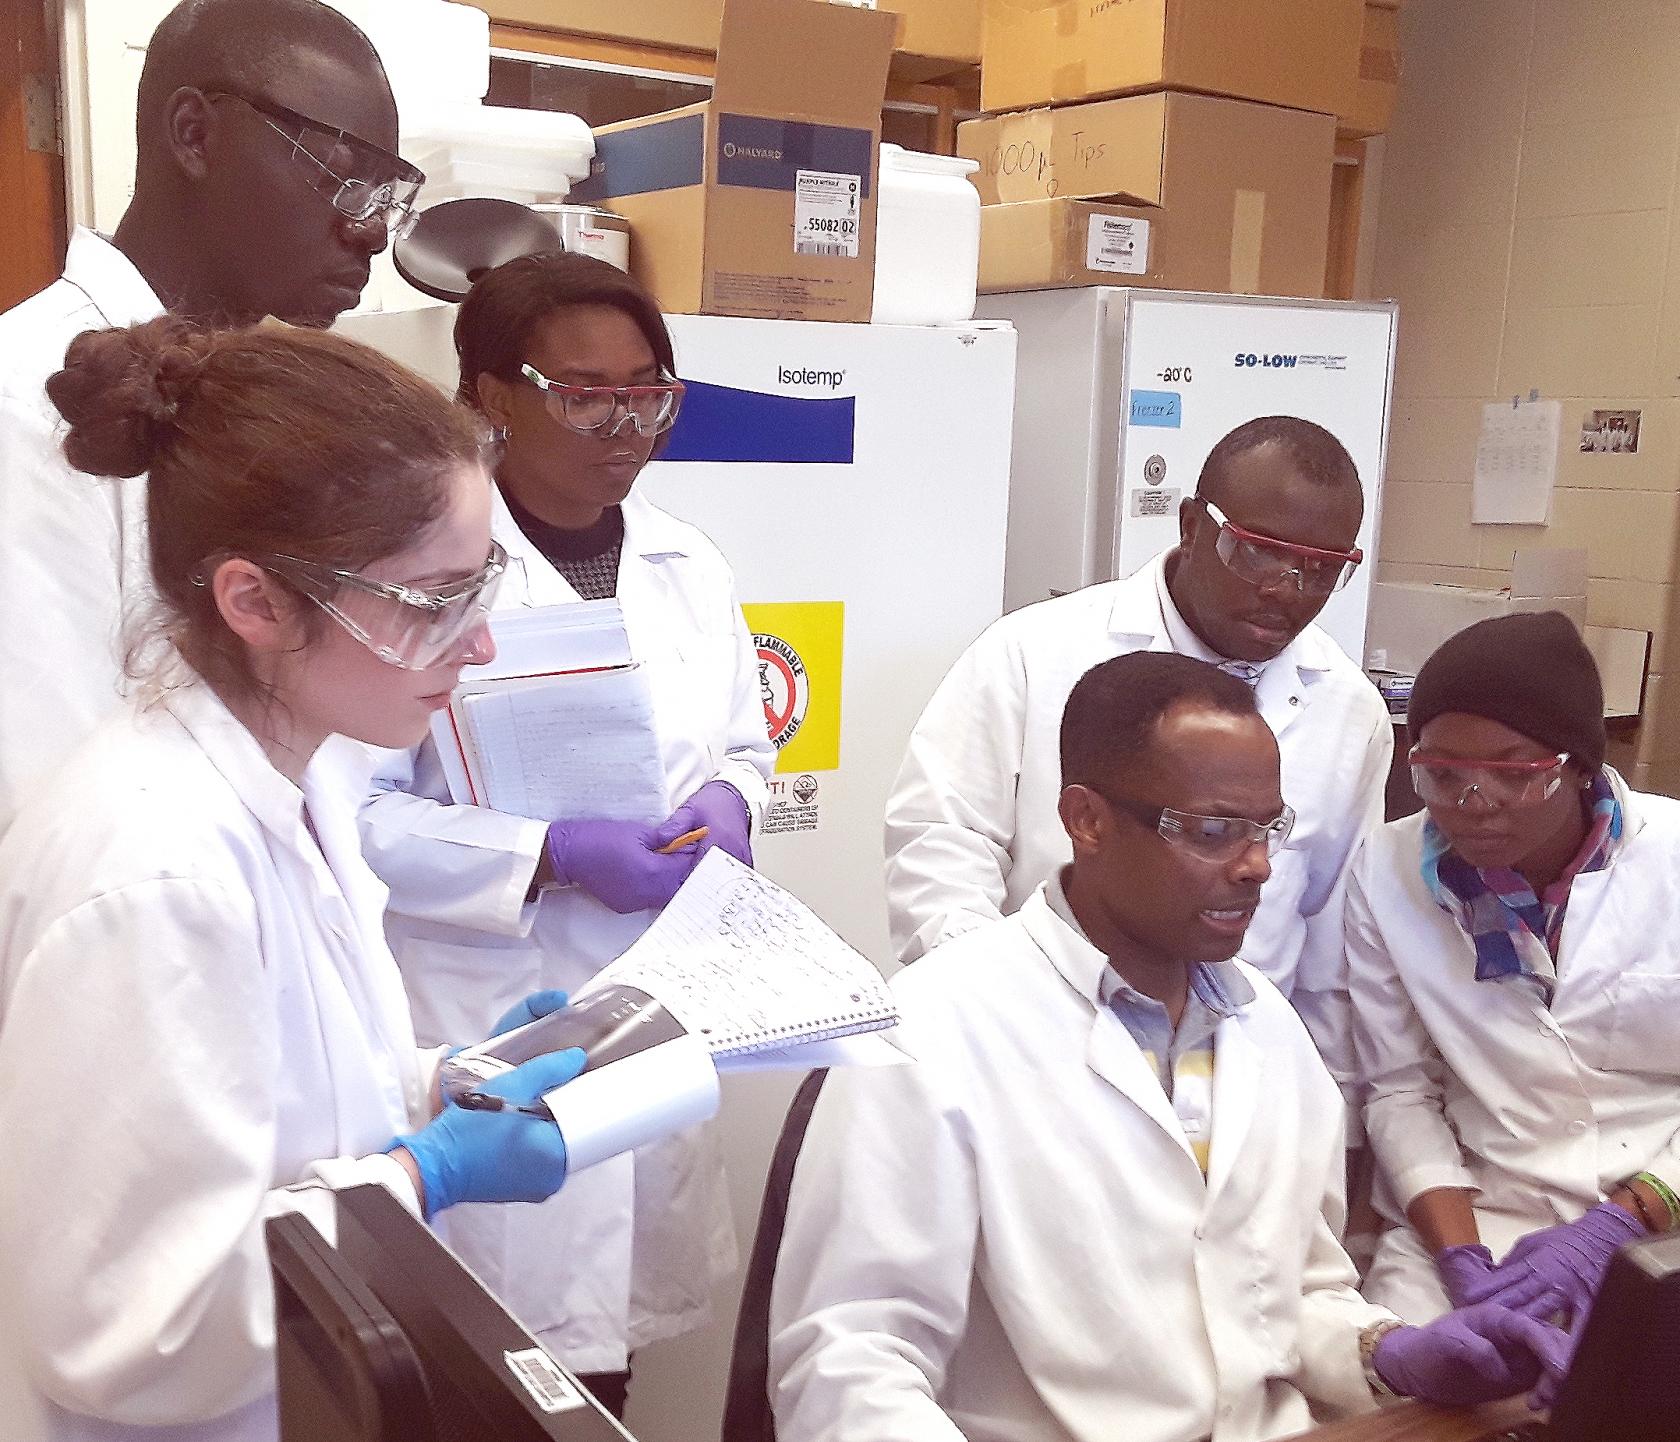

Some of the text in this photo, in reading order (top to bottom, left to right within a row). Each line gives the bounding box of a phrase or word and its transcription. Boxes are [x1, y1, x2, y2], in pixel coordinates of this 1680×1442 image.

[737, 146, 782, 160] HALYARD
[1072, 131, 1107, 169] Tips
[808, 217, 855, 234] 55082 02
[1234, 353, 1297, 368] SO-LOW
[778, 364, 844, 390] Isotemp
[753, 636, 804, 678] FLAMMABLE
[772, 716, 801, 750] ORAGE
